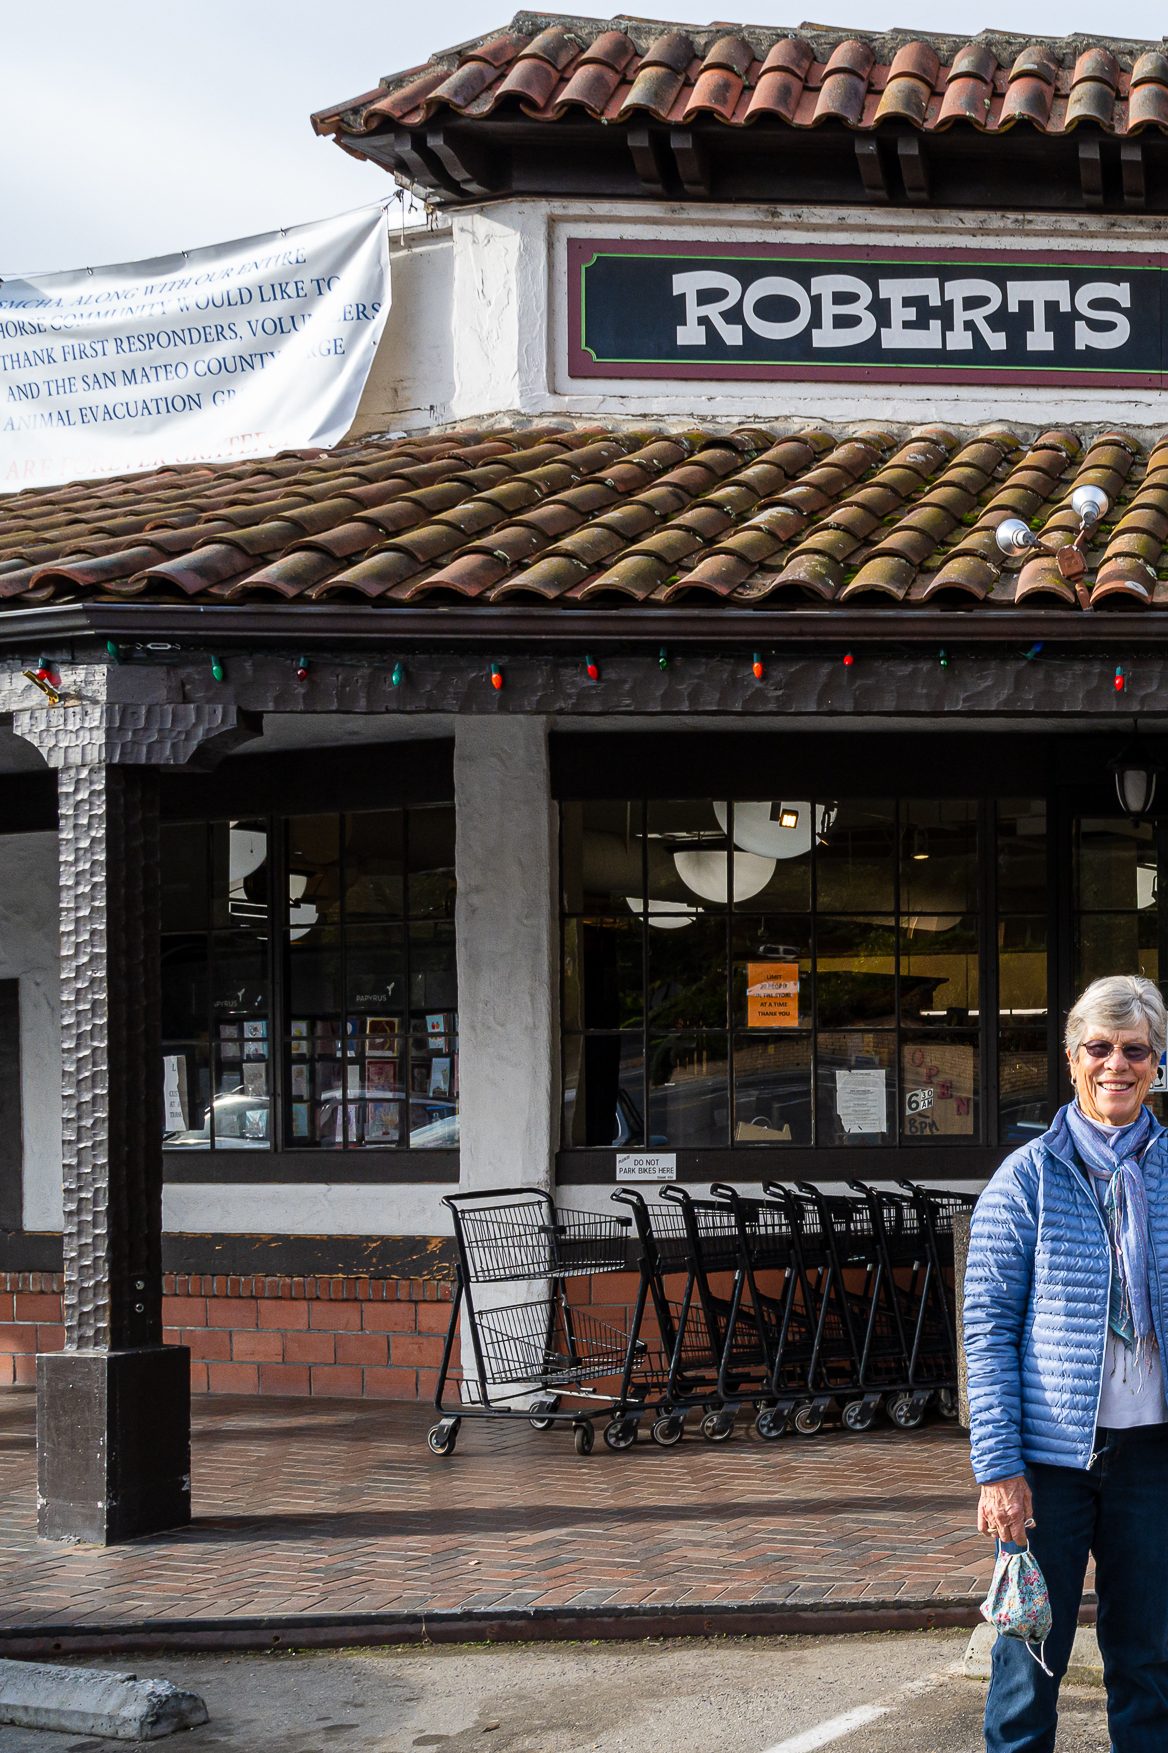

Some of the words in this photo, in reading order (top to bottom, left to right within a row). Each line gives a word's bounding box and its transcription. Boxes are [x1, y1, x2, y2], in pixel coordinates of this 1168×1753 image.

[71, 287, 139, 306] ALONG
[144, 278, 191, 296] WITH
[195, 267, 235, 286] OUR
[237, 248, 307, 276] ENTIRE
[177, 287, 253, 313] WOULD
[258, 281, 308, 303] LIKE
[310, 275, 341, 298] TO
[672, 270, 1131, 352] ROBERTS
[1, 347, 58, 371] THANK
[62, 339, 109, 362] FIRST
[114, 322, 243, 355] RESPONDERS,
[7, 382, 40, 402] AND
[43, 376, 79, 397] THE
[81, 371, 118, 392] SAN
[121, 361, 189, 387] MATEO
[3, 408, 76, 432] ANIMAL
[80, 393, 203, 425] EVACUATION
